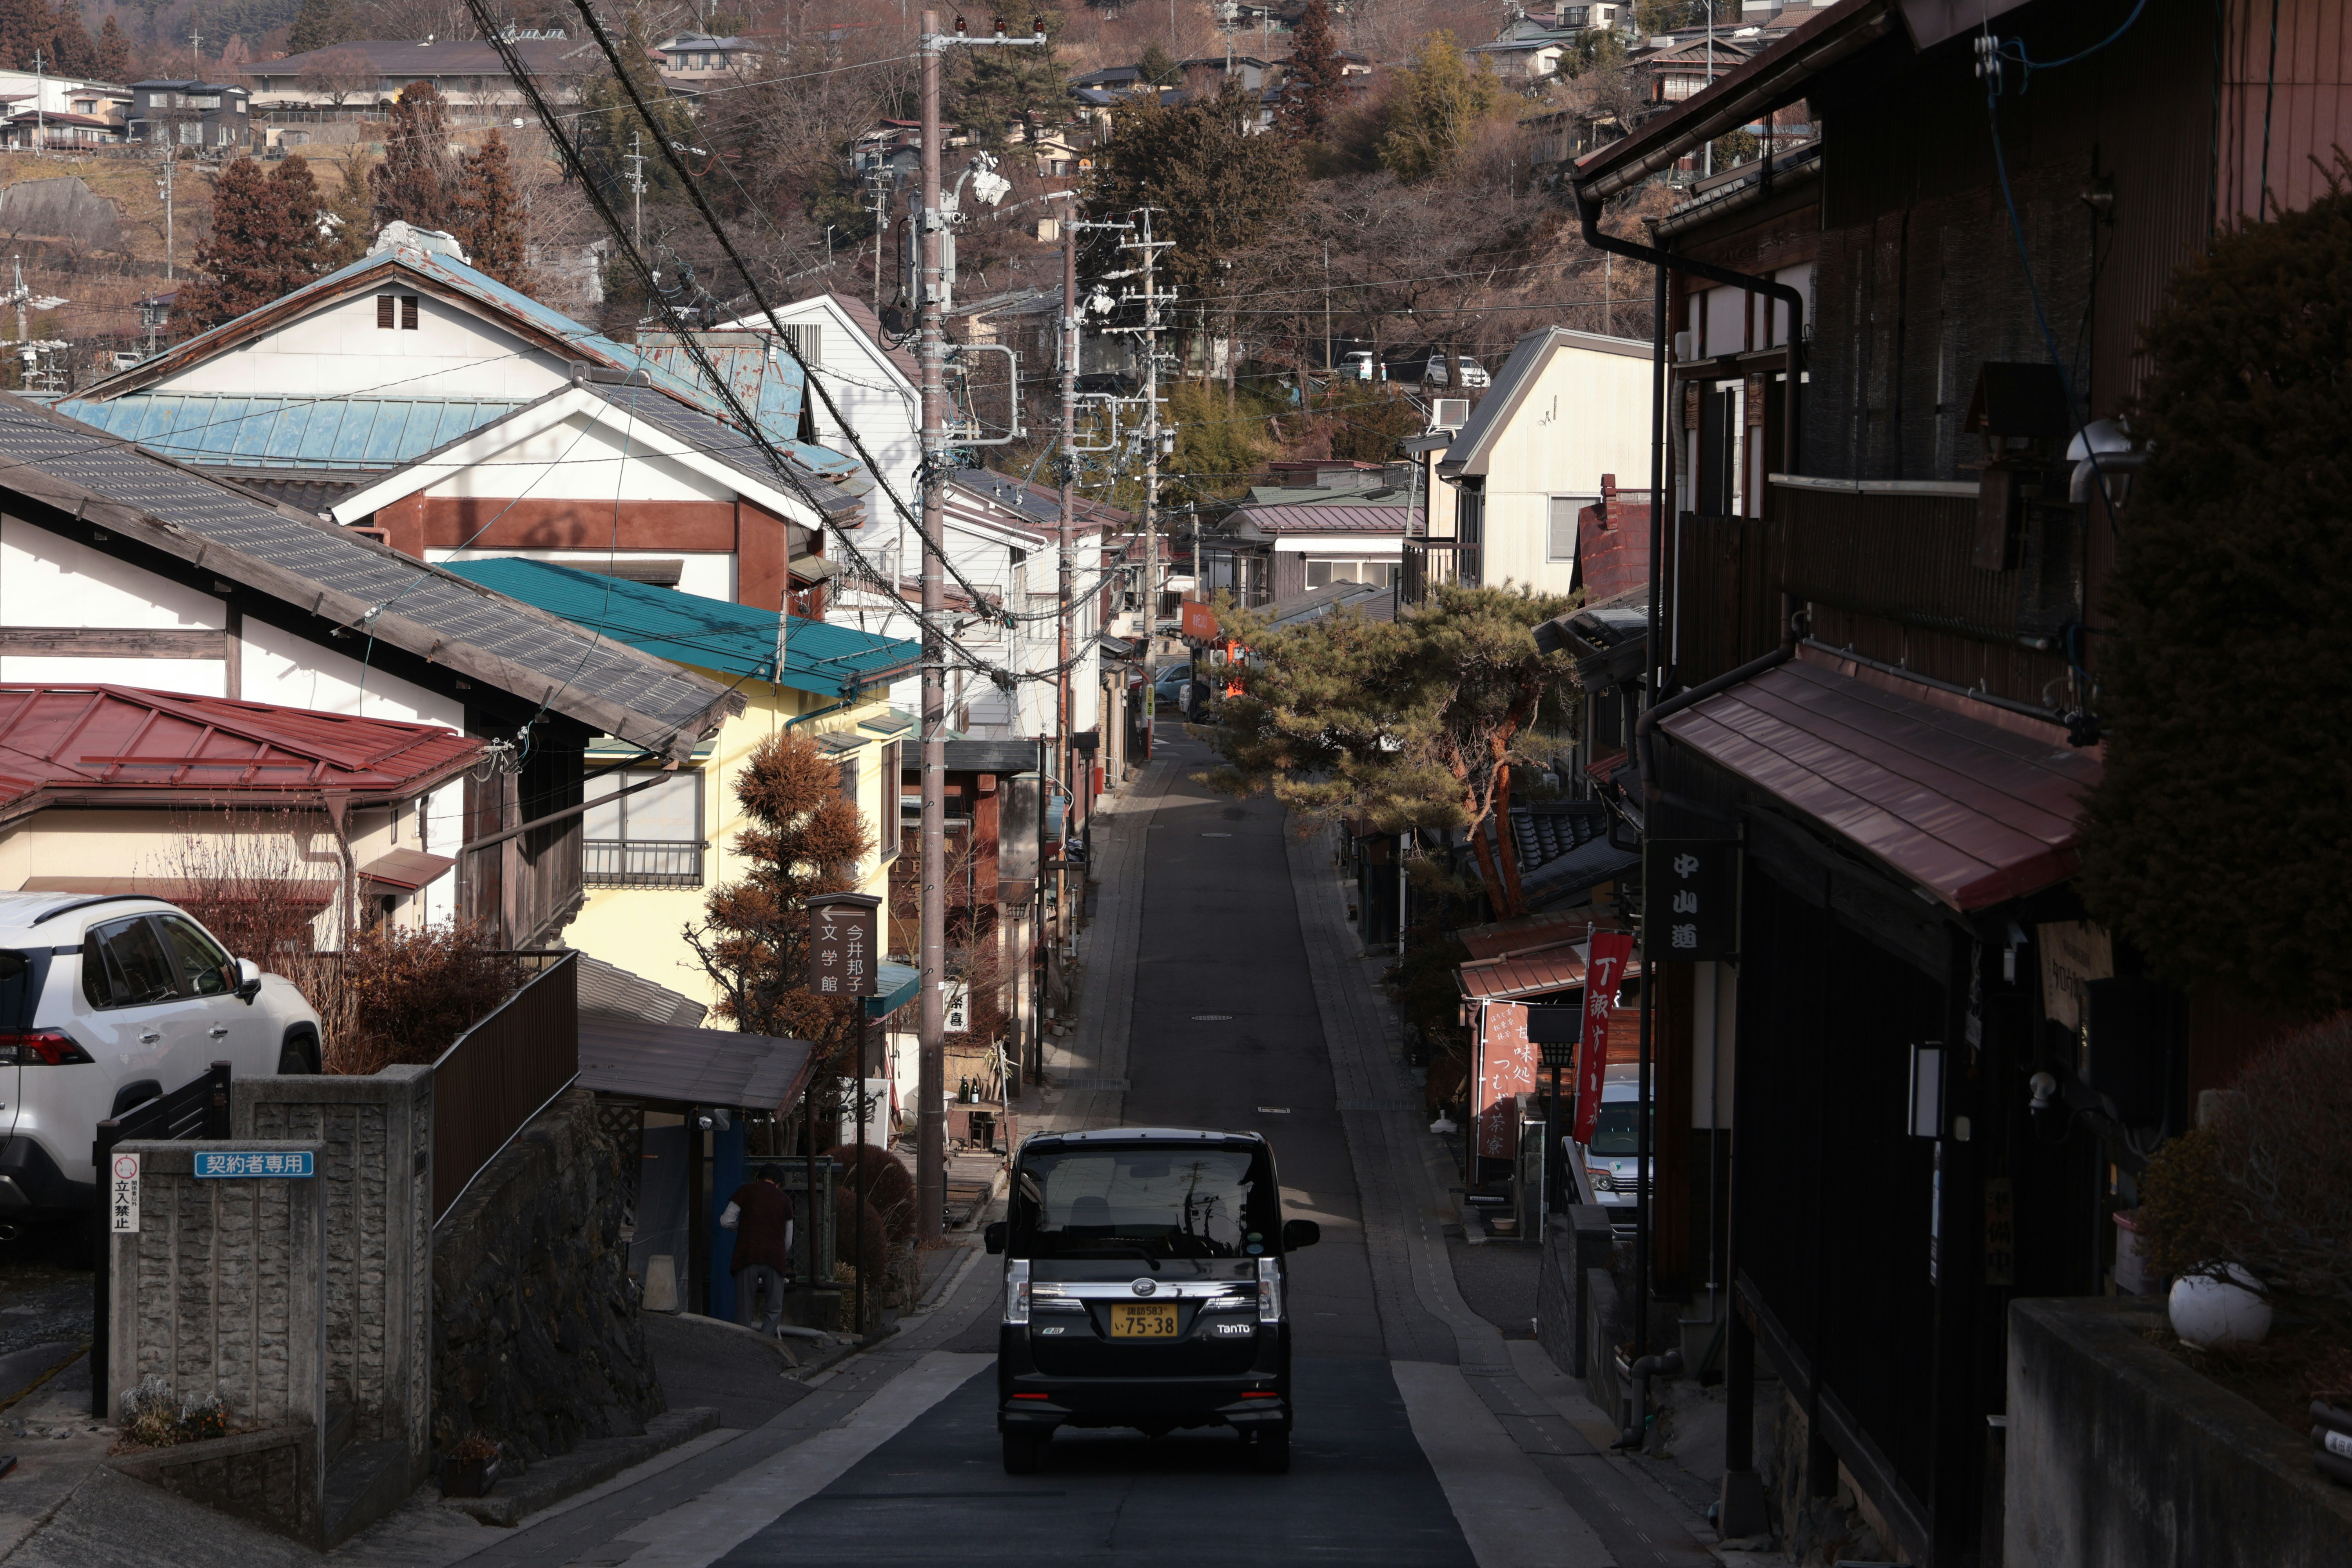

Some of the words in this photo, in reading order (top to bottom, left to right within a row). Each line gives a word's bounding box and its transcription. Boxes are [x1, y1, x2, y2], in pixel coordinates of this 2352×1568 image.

[1671, 853, 1699, 948] 中山道
[821, 924, 838, 991] 文学館
[847, 925, 863, 991] 今井邦子
[1490, 1008, 1513, 1022] ほうじ茶
[1493, 1018, 1514, 1031] 松葉茶
[1497, 1030, 1511, 1040] 抹茶
[1514, 1024, 1532, 1083] 甘味処
[1486, 1059, 1510, 1155] つむぎ茶寮
[207, 1154, 302, 1173] 契約者専用
[114, 1180, 130, 1229] 立入禁止
[1126, 1317, 1174, 1334] 75-38
